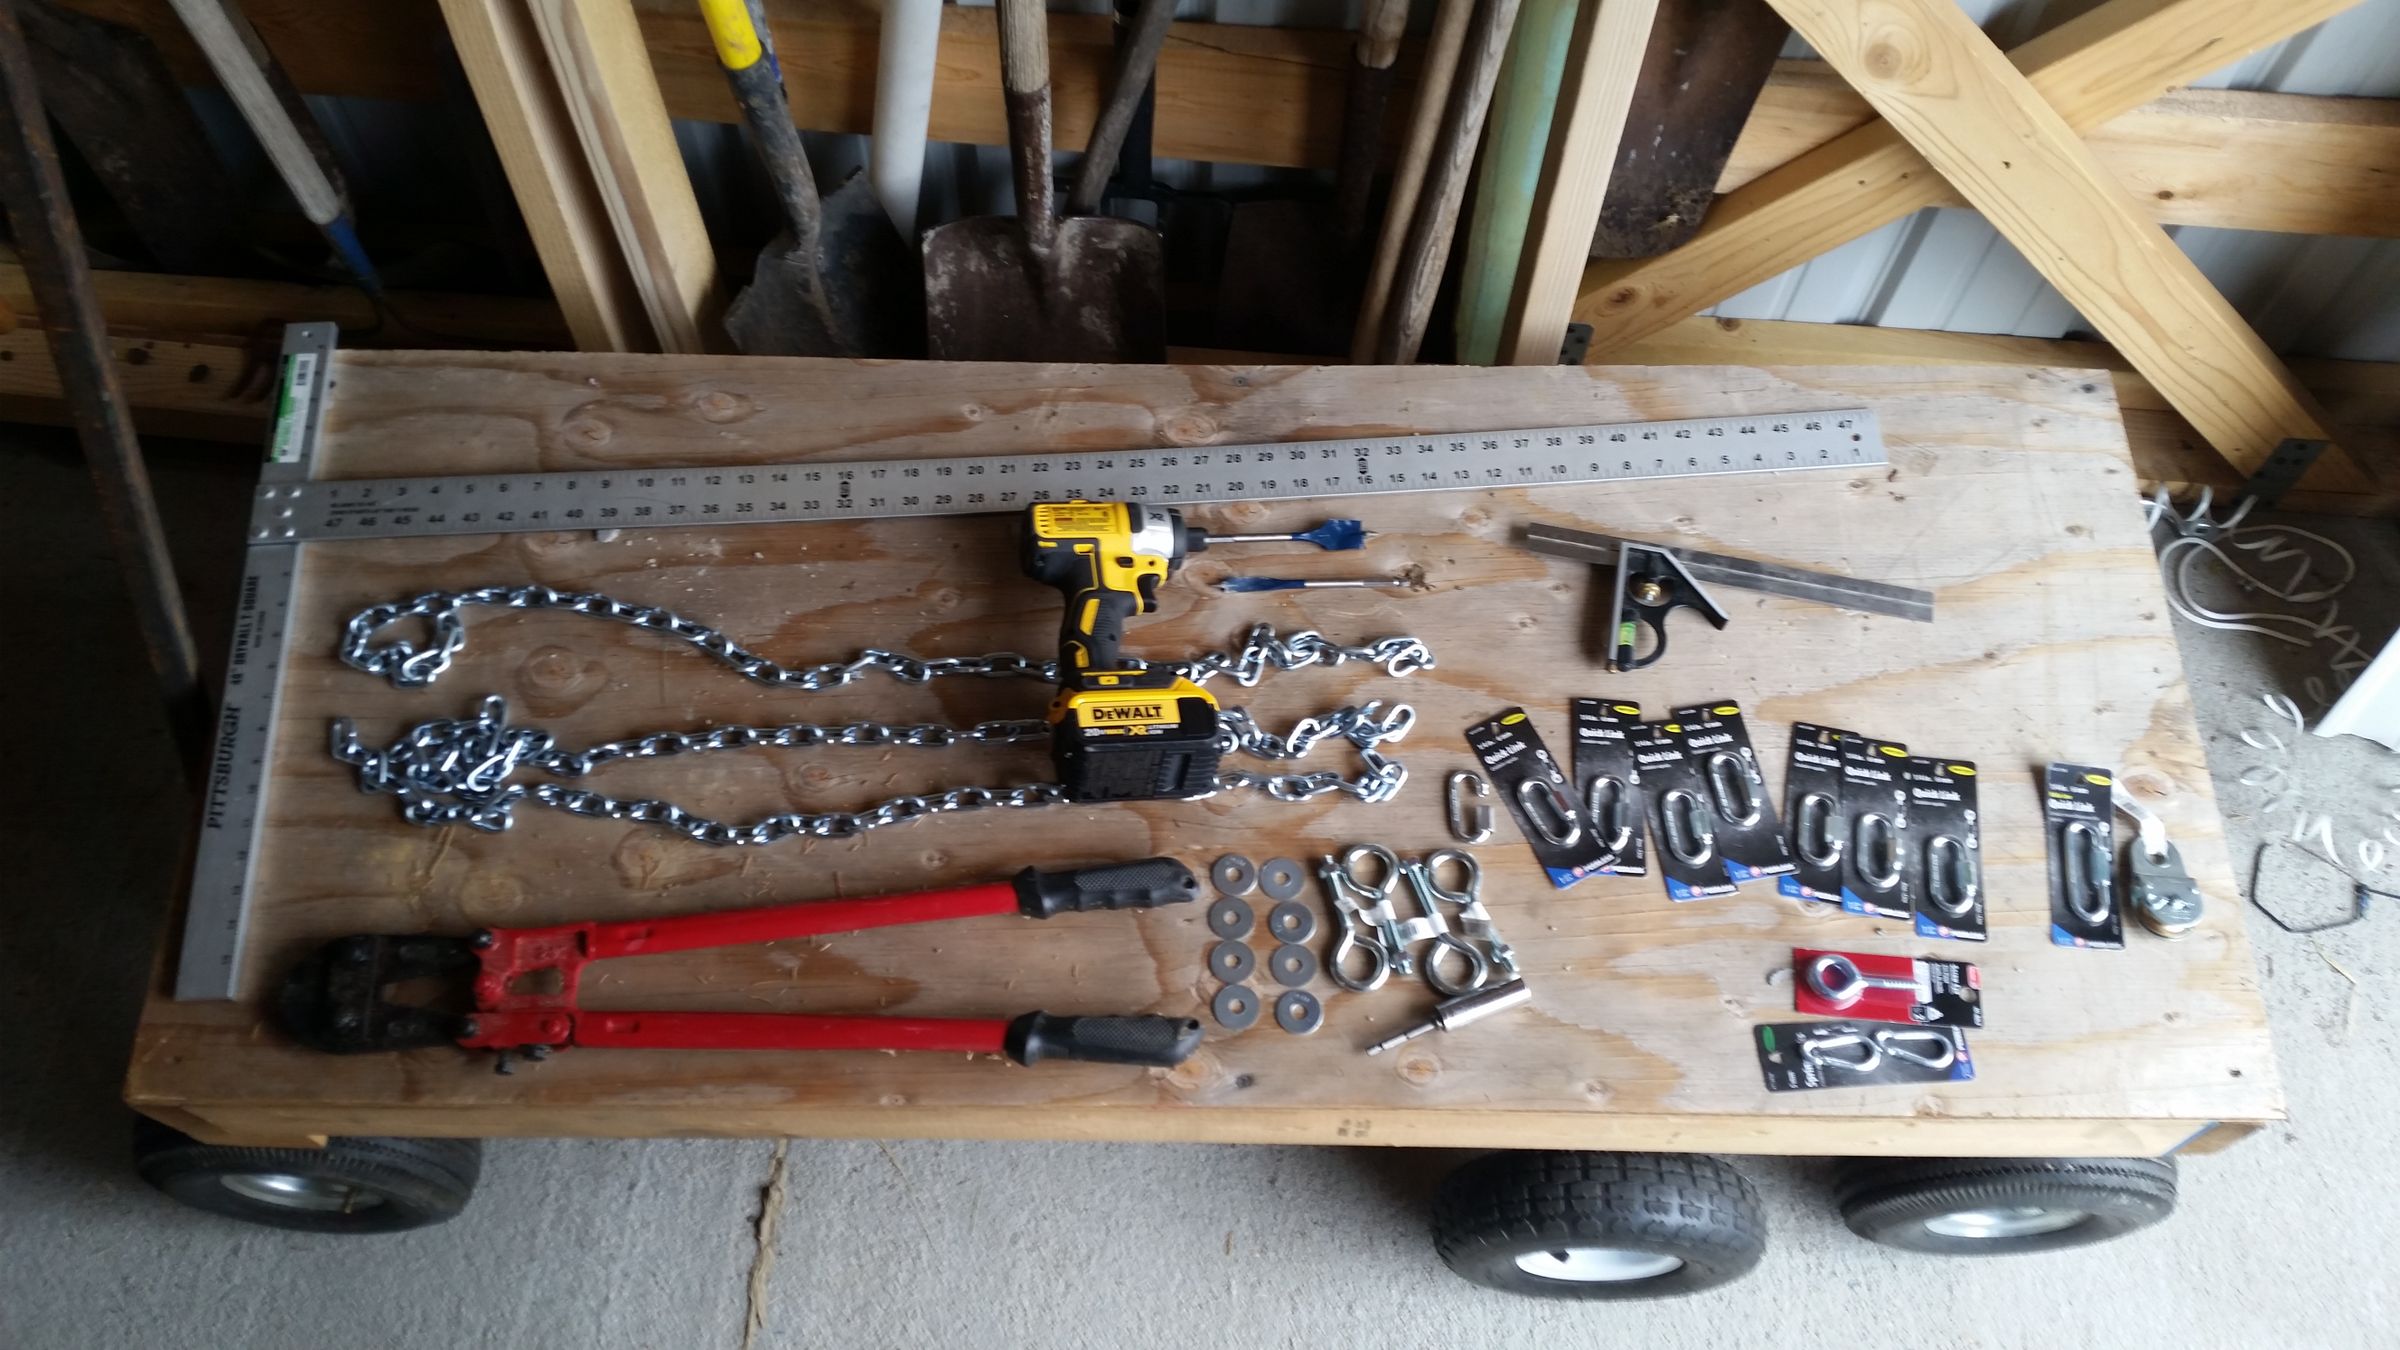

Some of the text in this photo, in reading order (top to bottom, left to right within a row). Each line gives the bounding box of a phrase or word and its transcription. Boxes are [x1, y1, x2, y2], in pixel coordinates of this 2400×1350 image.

[637, 477, 655, 488] 10
[671, 477, 686, 486] 11
[704, 475, 722, 485] 12
[738, 474, 755, 484] 13
[771, 473, 788, 482] 14
[804, 472, 822, 481] 15
[837, 470, 855, 480] 16
[870, 470, 885, 478] 17
[903, 468, 920, 477] 18
[936, 466, 952, 476] 19
[968, 465, 984, 475] 20
[1000, 464, 1016, 474] 21
[1032, 462, 1049, 472] 22
[1064, 461, 1082, 471] 23
[1097, 460, 1113, 470] 24
[1129, 458, 1146, 468] 25
[1162, 457, 1178, 466] 26
[1193, 455, 1210, 465] 27
[1226, 454, 1242, 463] 28
[1258, 452, 1274, 461] 29
[1289, 450, 1306, 460] 30
[1321, 449, 1337, 459] 31
[1353, 447, 1370, 457] 32
[1385, 445, 1402, 455] 33
[1418, 444, 1434, 454] 34
[1450, 442, 1466, 452] 35
[1482, 440, 1498, 450] 36
[1514, 439, 1530, 448] 37
[1546, 437, 1562, 447] 38
[1578, 435, 1594, 444] 39
[1610, 433, 1626, 442] 40
[1642, 432, 1658, 440] 41
[1675, 429, 1691, 439] 42
[1707, 428, 1724, 437] 43
[1740, 426, 1756, 434] 44
[1772, 423, 1789, 433] 45
[1805, 422, 1822, 431] 46
[1838, 419, 1855, 429] 47
[324, 447, 1862, 528] 47 46 45 44 43 42 41 40 39 38 37 36 35 34 33 32 31 30 29 28 27 26 25 24 23 22 21 20 19 18 17 16 15 14 13 12 11 10 9 8 7 6 5 4 3 2 1
[1148, 512, 1165, 521] XR
[234, 622, 253, 665] DRYWALL
[1579, 728, 1605, 738] Quick
[1688, 737, 1712, 748] Quick
[1484, 749, 1510, 764] Quick
[1638, 752, 1662, 764] Quick
[1794, 752, 1819, 764] Quick
[206, 703, 240, 828] PITTSBURGH
[1844, 766, 1870, 778] Quick
[1912, 788, 1938, 799] Quick
[2048, 798, 2074, 810] Quick
